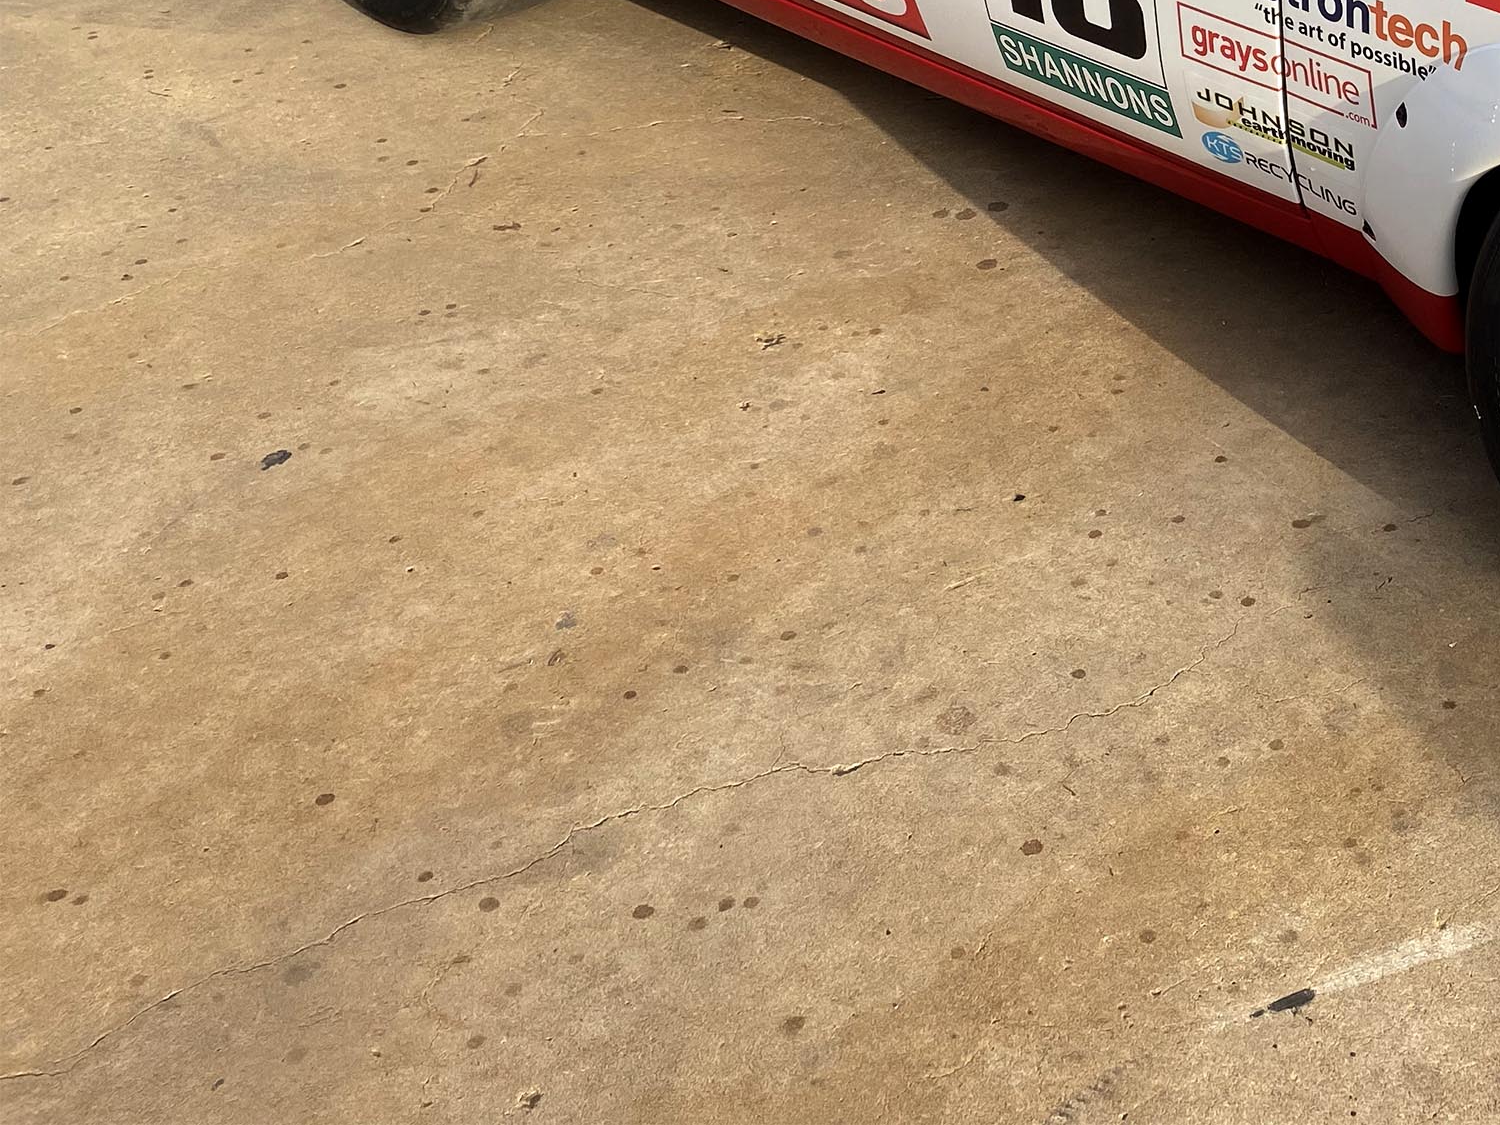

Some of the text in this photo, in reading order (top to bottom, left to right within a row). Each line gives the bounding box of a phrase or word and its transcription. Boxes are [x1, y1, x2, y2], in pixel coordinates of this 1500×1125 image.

[1191, 24, 1361, 106] graysonline
[1298, 23, 1324, 43] art
[1327, 32, 1346, 50] of
[1000, 33, 1172, 128] SHANNONS
[1197, 87, 1354, 159] JOHNSON
[1345, 111, 1371, 127] .com
[1206, 135, 1358, 216] KTS RECYCLING
